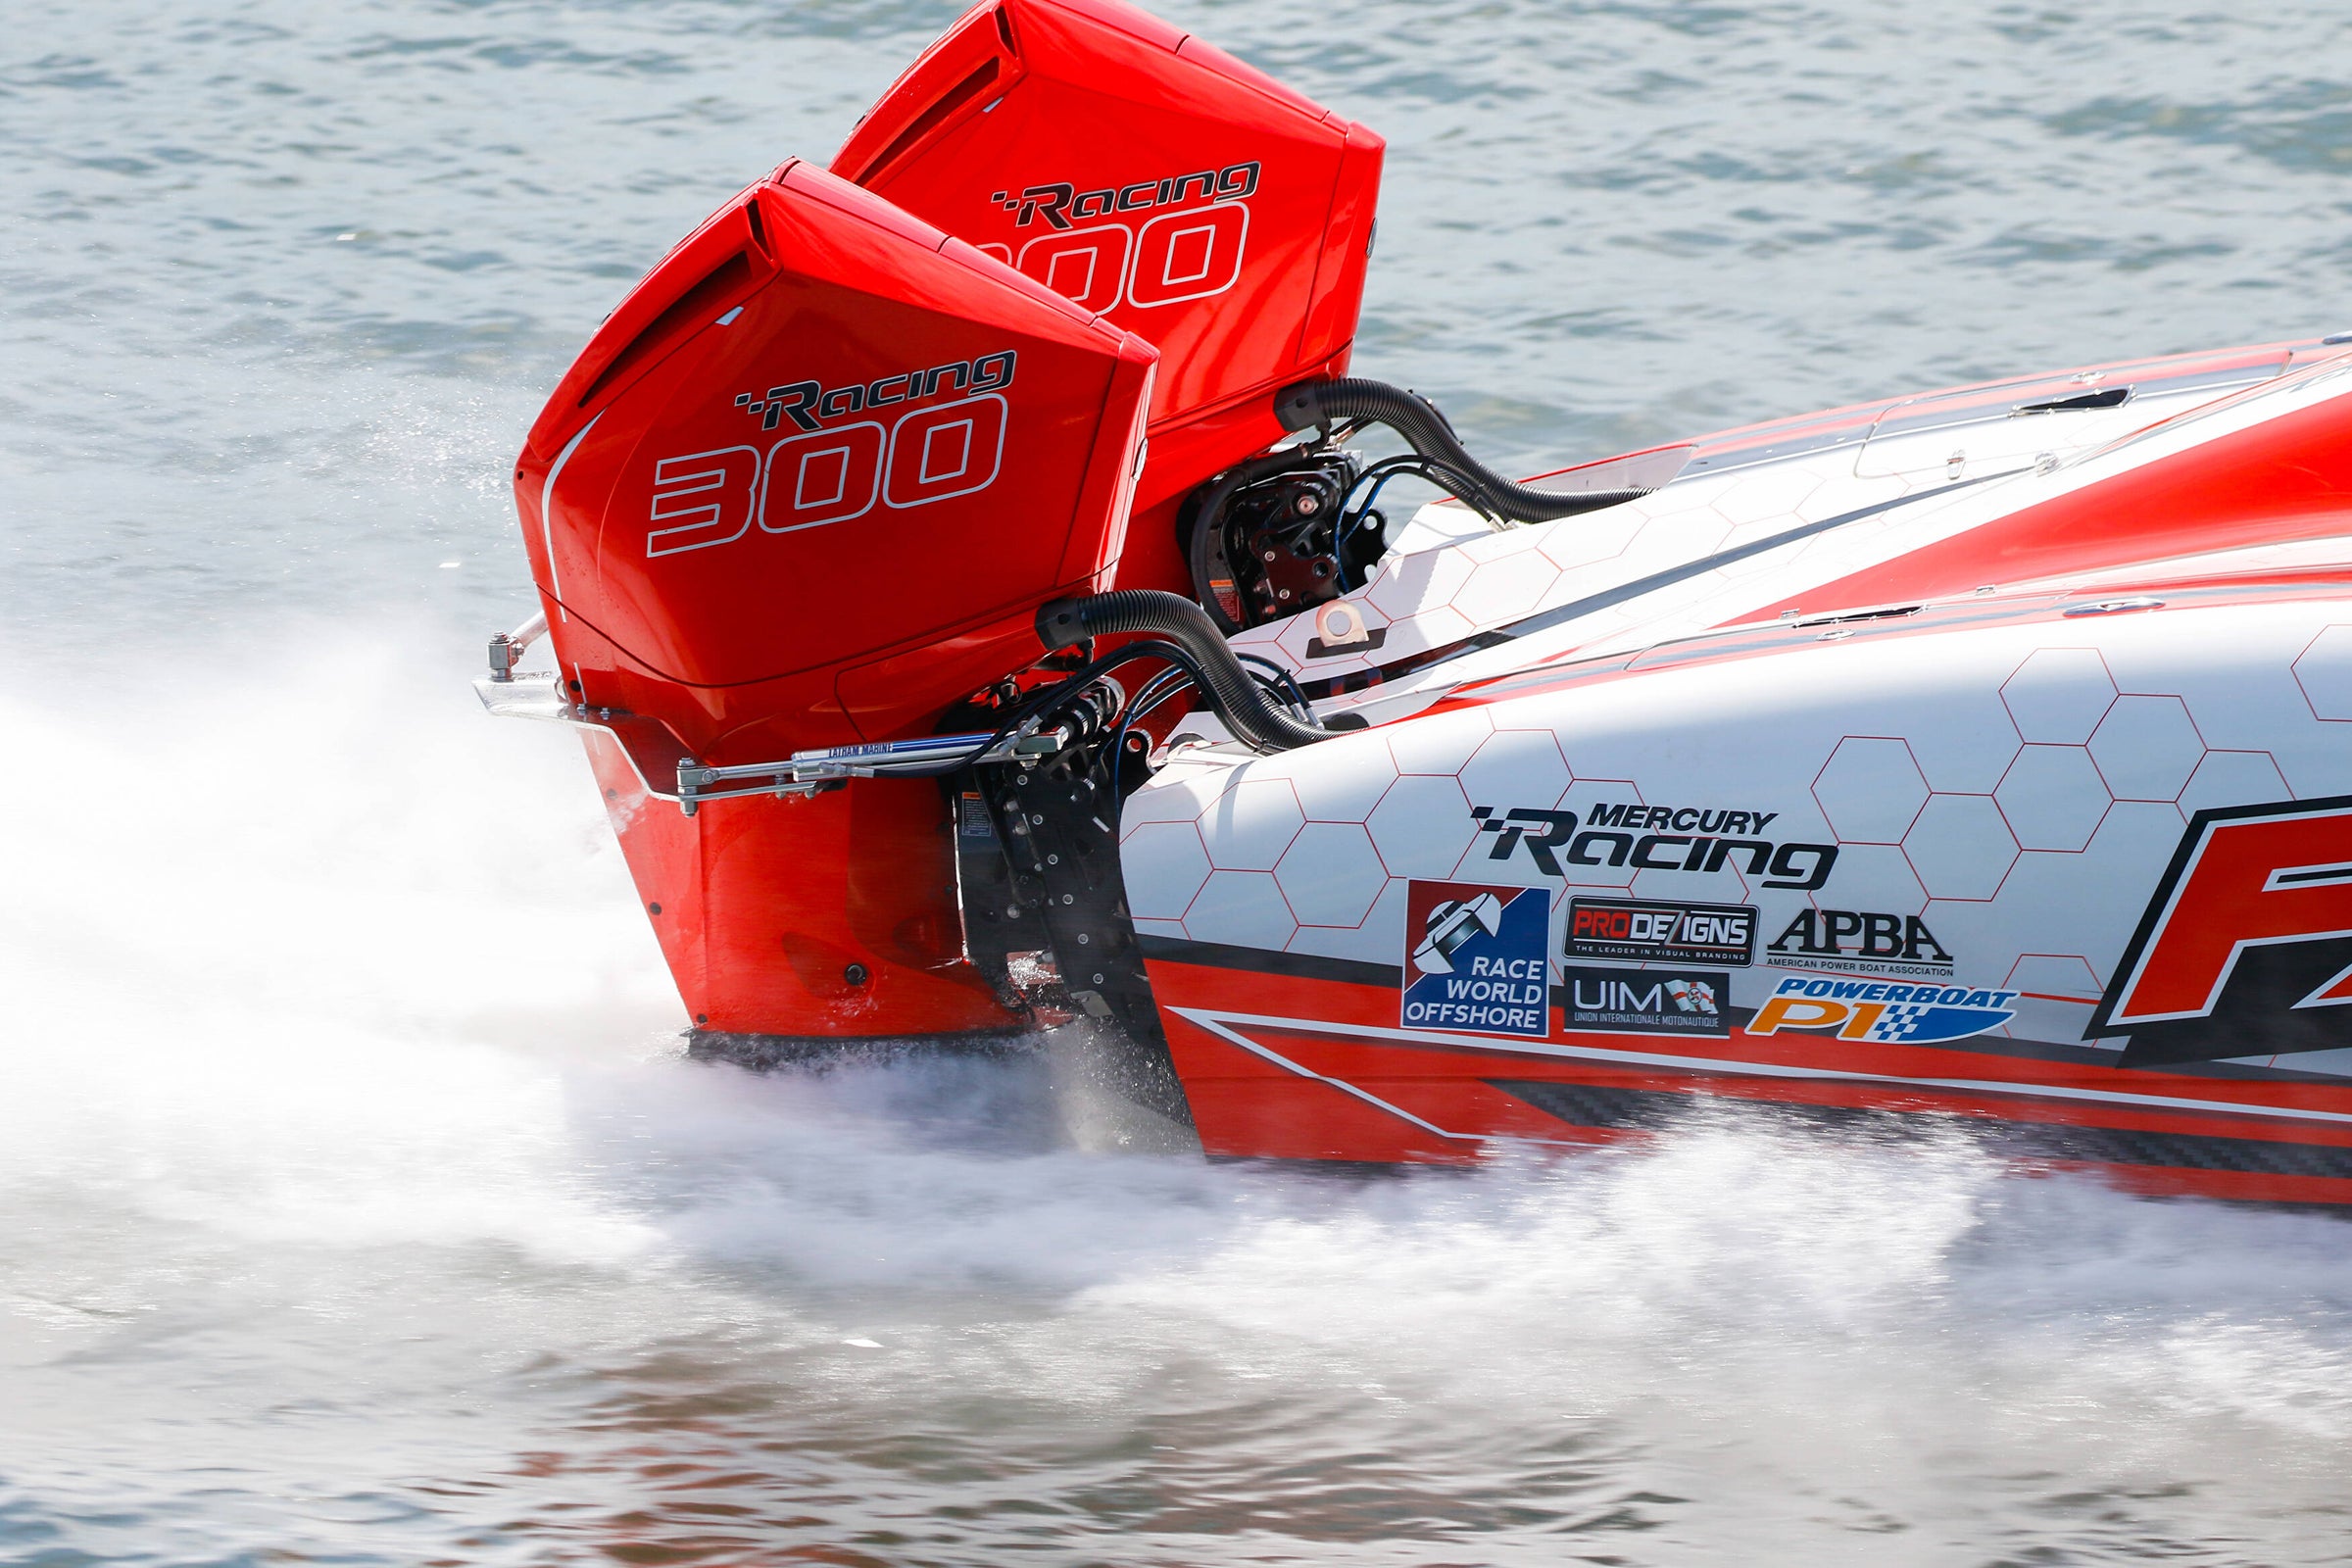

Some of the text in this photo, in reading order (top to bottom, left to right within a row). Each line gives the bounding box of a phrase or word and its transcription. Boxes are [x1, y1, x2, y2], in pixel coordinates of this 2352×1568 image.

[1015, 161, 1261, 229] Racing
[975, 201, 1250, 317] 00
[760, 349, 1017, 431] Racing
[646, 392, 1008, 558] 300
[829, 742, 893, 759] LATHAM MARINE
[1586, 803, 1779, 835] MERCURY
[1488, 808, 1839, 891] Racing
[1767, 908, 1953, 961] APBA
[1471, 956, 1544, 980] RACE
[1598, 946, 1636, 955] LEADER
[1695, 952, 1745, 960] BRANDING
[1767, 957, 1954, 977] AMERICAN POWER BOAT ASSOCIATION
[1446, 979, 1543, 1004] WORLD
[1574, 979, 1662, 1012] UIM
[1776, 978, 2018, 1008] POWERBOAT
[1406, 1002, 1541, 1029] OFFSHORE
[1574, 1011, 1719, 1028] UNION INTERNATIONALE MOTONAUTIQUE
[1748, 998, 1887, 1039] P1
